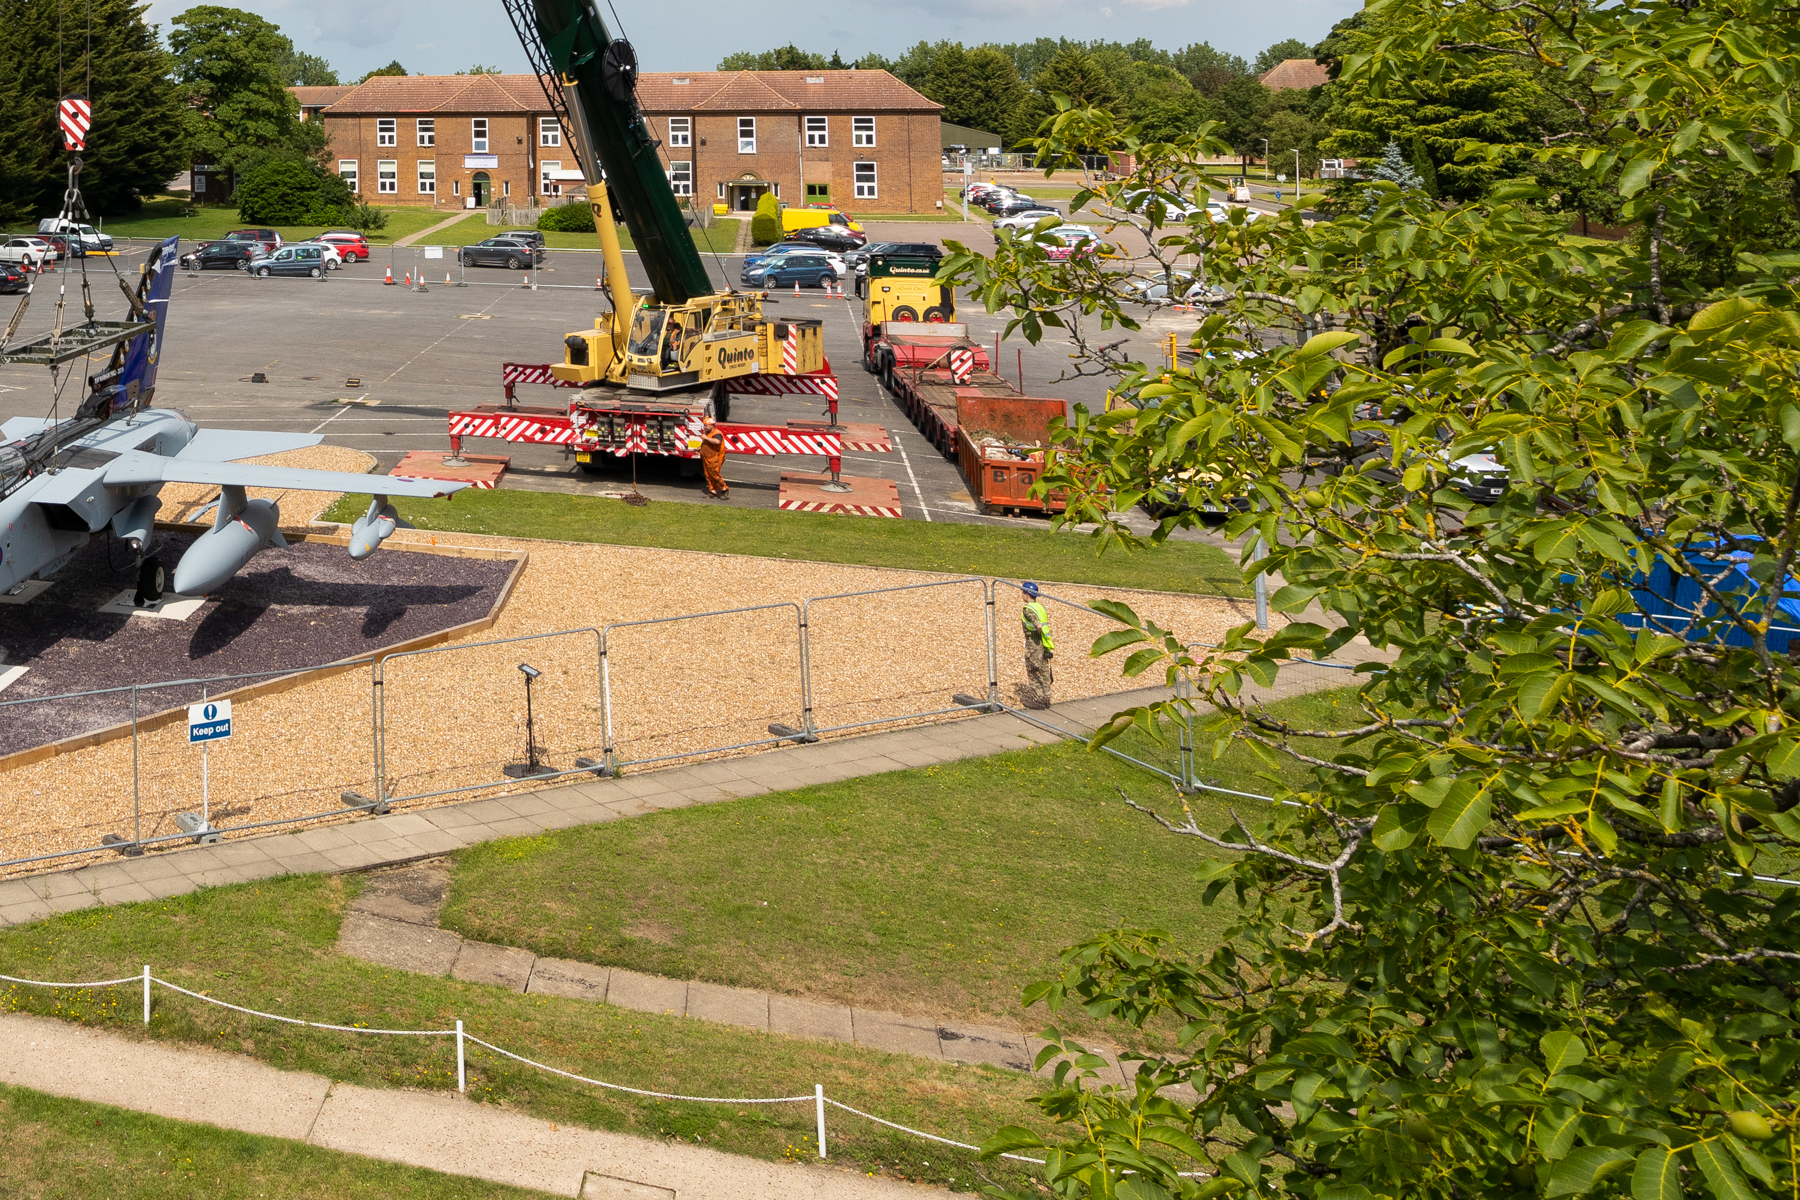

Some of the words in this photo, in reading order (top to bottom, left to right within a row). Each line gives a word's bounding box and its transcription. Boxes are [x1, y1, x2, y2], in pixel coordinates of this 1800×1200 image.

[717, 347, 754, 370] Quinto
[630, 367, 657, 375] Quinto
[193, 726, 214, 737] Keep
[215, 722, 229, 733] out
